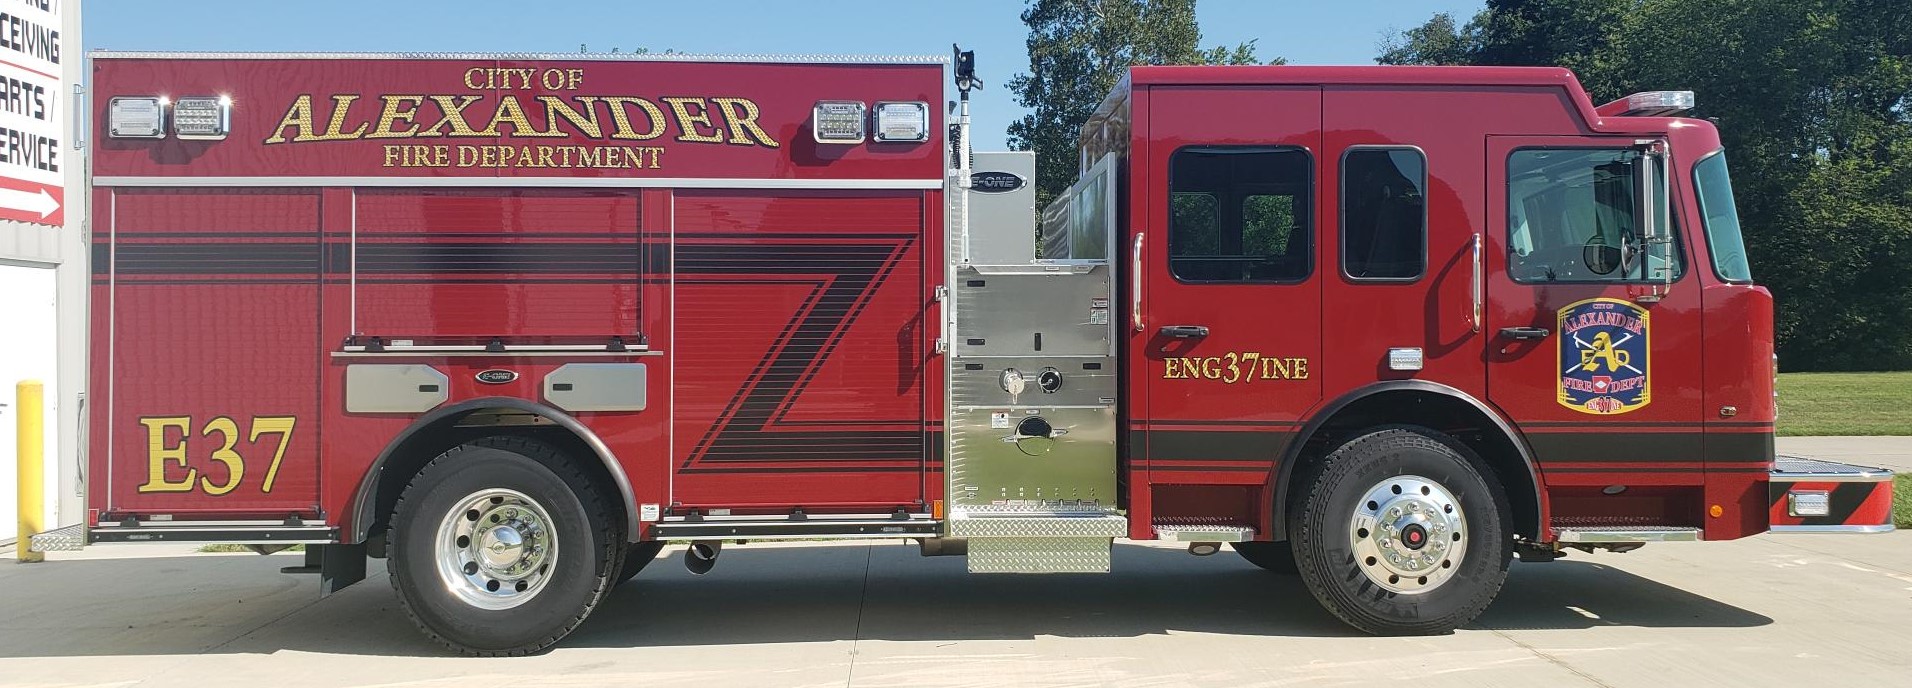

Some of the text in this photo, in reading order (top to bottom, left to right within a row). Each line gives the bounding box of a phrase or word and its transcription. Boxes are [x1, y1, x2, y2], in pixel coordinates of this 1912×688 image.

[463, 67, 584, 90] CITY OF
[263, 93, 780, 150] ALEXANDER
[382, 145, 665, 169] FIRE DEPARTMENT
[971, 176, 1015, 188] E-ONE
[1563, 311, 1643, 335] ALEXANDER
[1563, 375, 1645, 393] FIRE DEPT
[138, 415, 297, 496] E37
